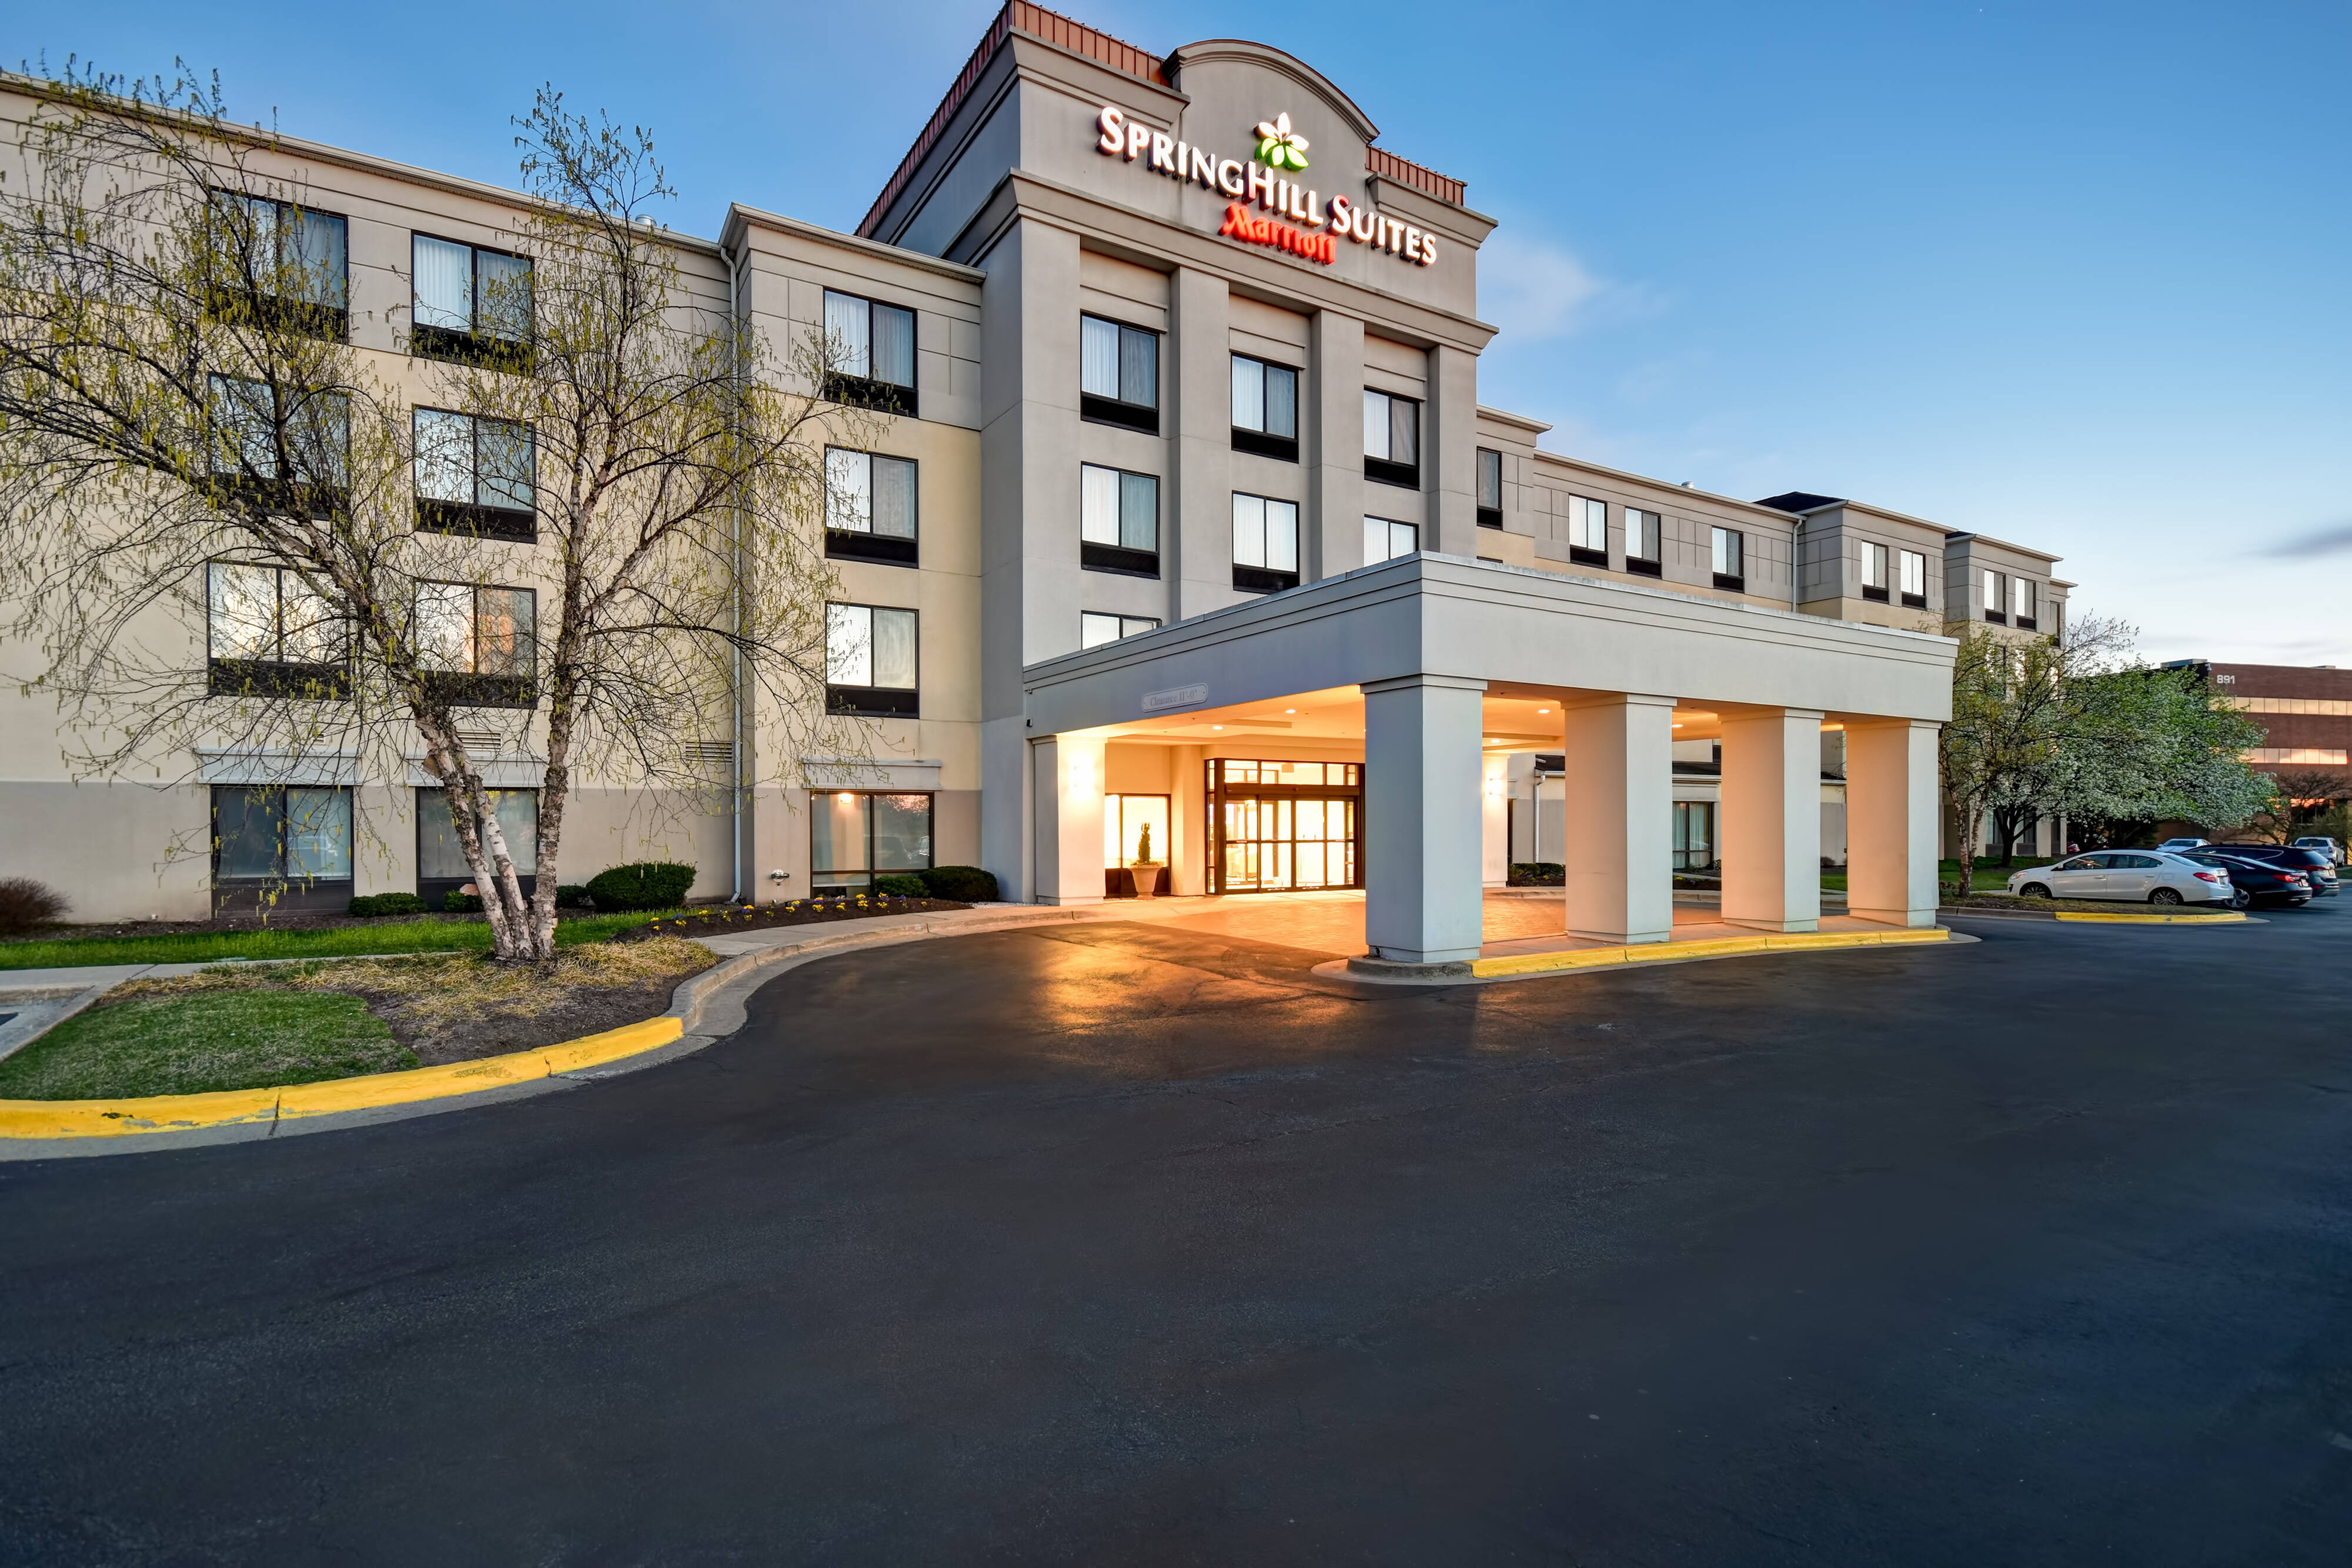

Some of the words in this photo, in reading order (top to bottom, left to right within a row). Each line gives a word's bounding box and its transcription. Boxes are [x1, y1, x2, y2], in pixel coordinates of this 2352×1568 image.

[1097, 106, 1324, 226] SPRINGHILL
[1327, 195, 1437, 266] SUITES
[1218, 202, 1337, 265] Marriott
[2217, 674, 2235, 684] 891
[1150, 696, 1177, 706] Clearance
